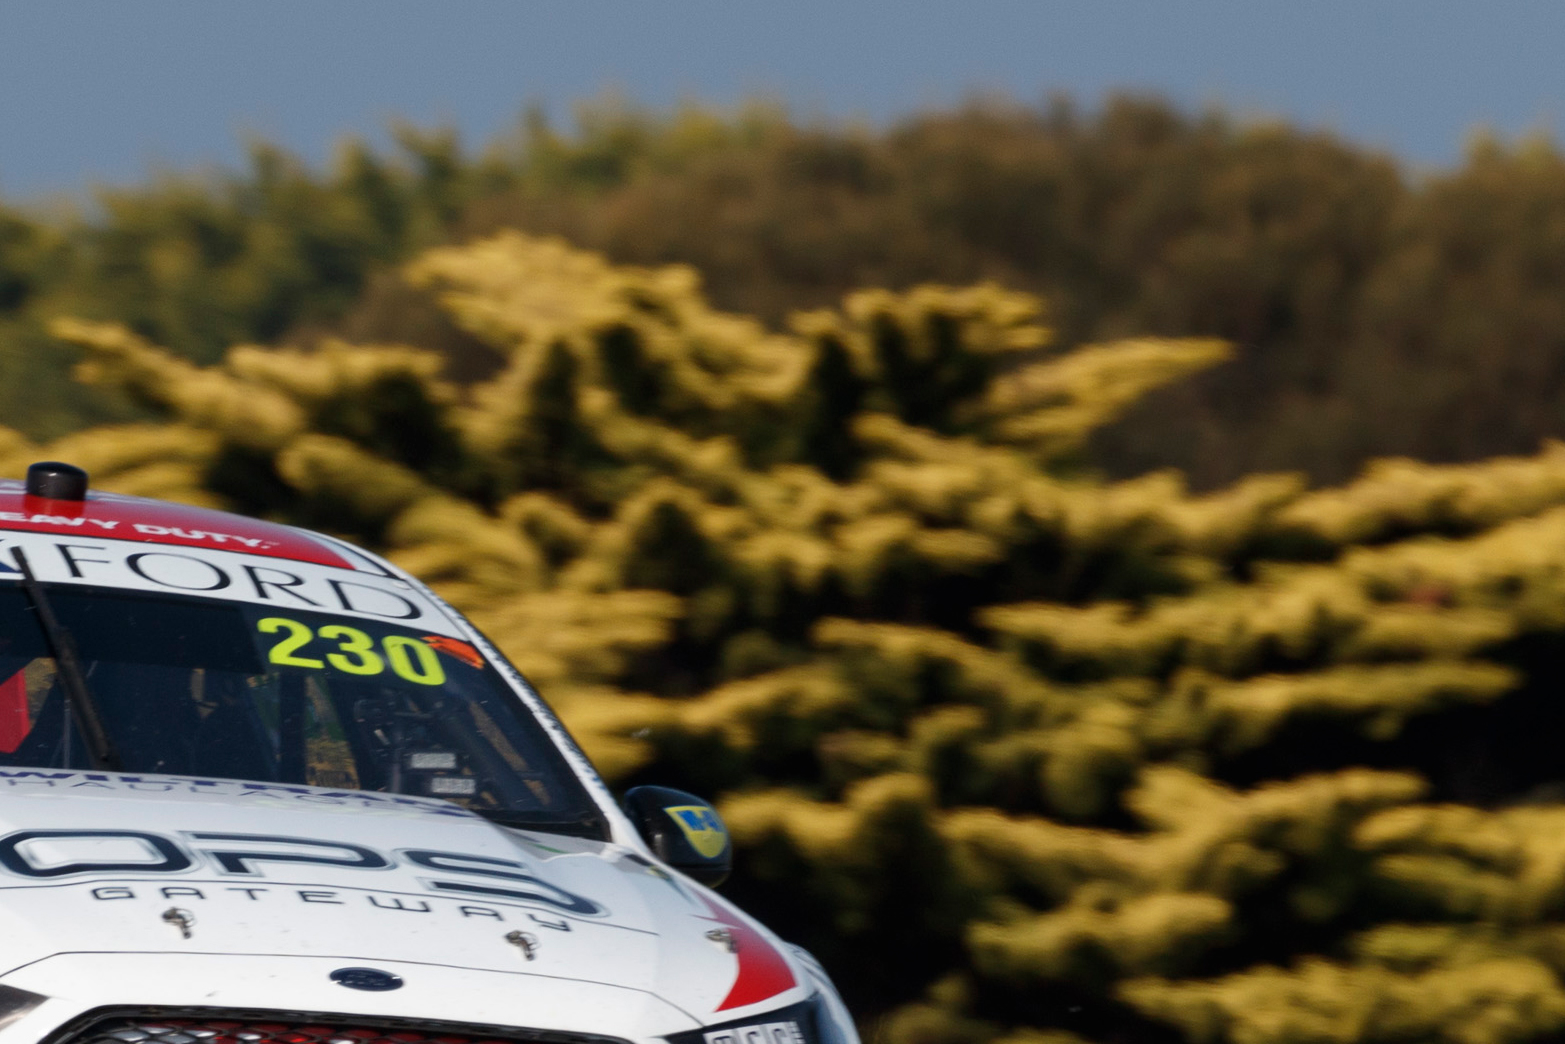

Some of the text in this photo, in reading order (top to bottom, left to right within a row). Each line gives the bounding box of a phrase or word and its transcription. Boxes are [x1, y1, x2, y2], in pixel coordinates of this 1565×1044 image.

[55, 543, 423, 621] FORD
[257, 616, 447, 686] 230
[90, 885, 573, 934] GATEWAY
